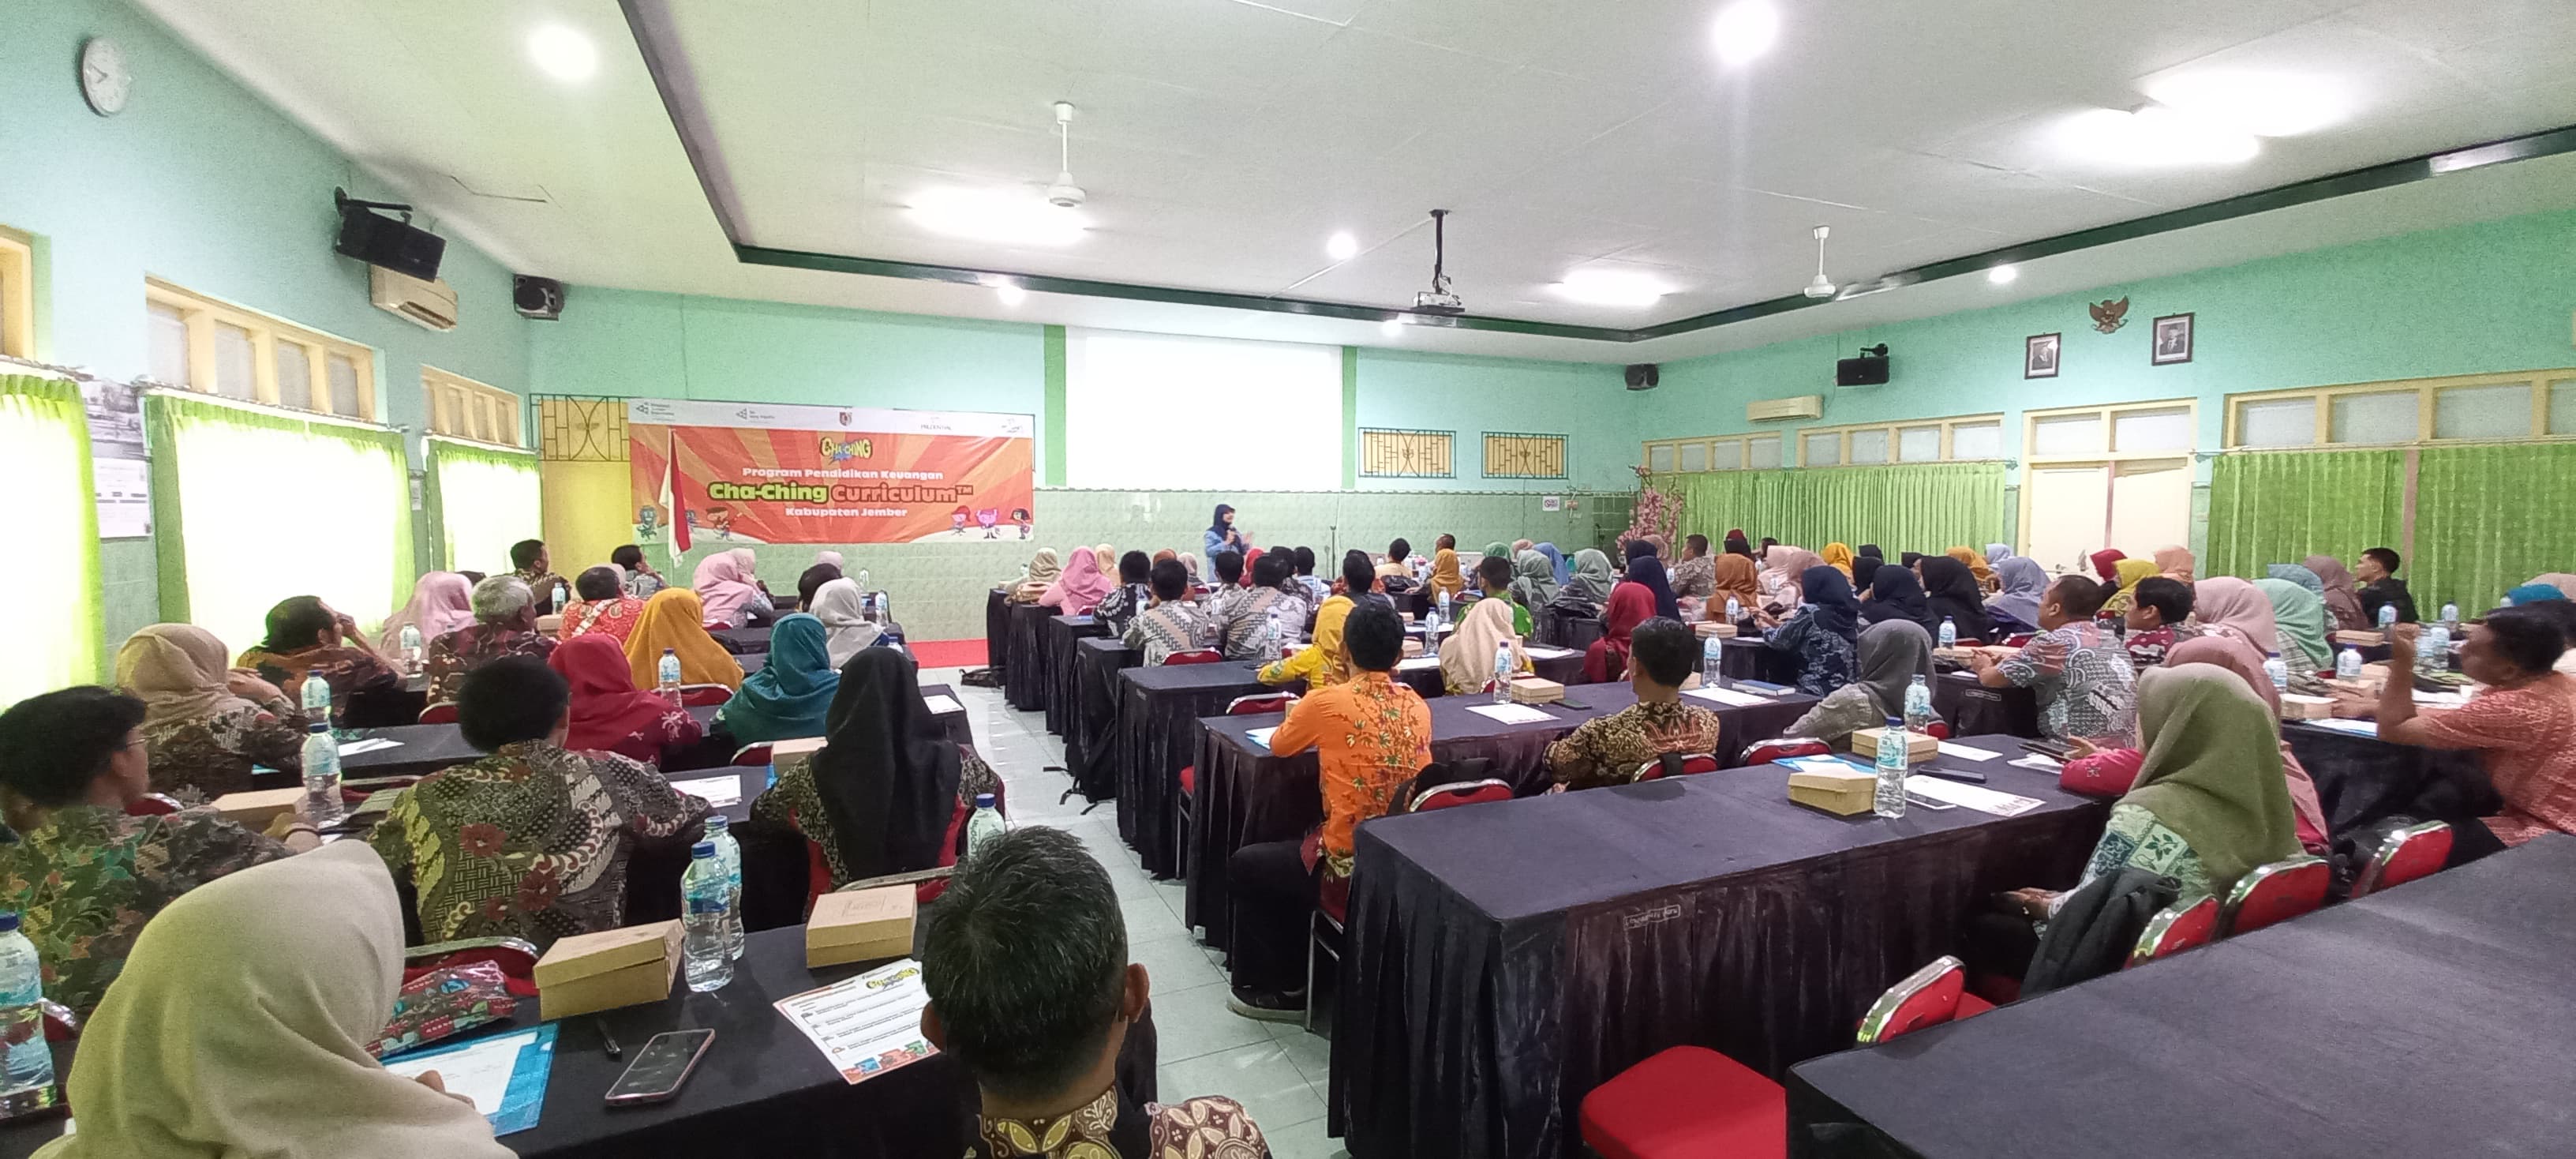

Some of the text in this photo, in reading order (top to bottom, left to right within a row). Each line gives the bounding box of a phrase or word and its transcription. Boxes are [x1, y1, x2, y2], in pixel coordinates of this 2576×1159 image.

[742, 467, 944, 481] Program Pendidikan Keuangan
[708, 480, 829, 504] Cha-Ching
[784, 508, 908, 517] Kabupaten Jember
